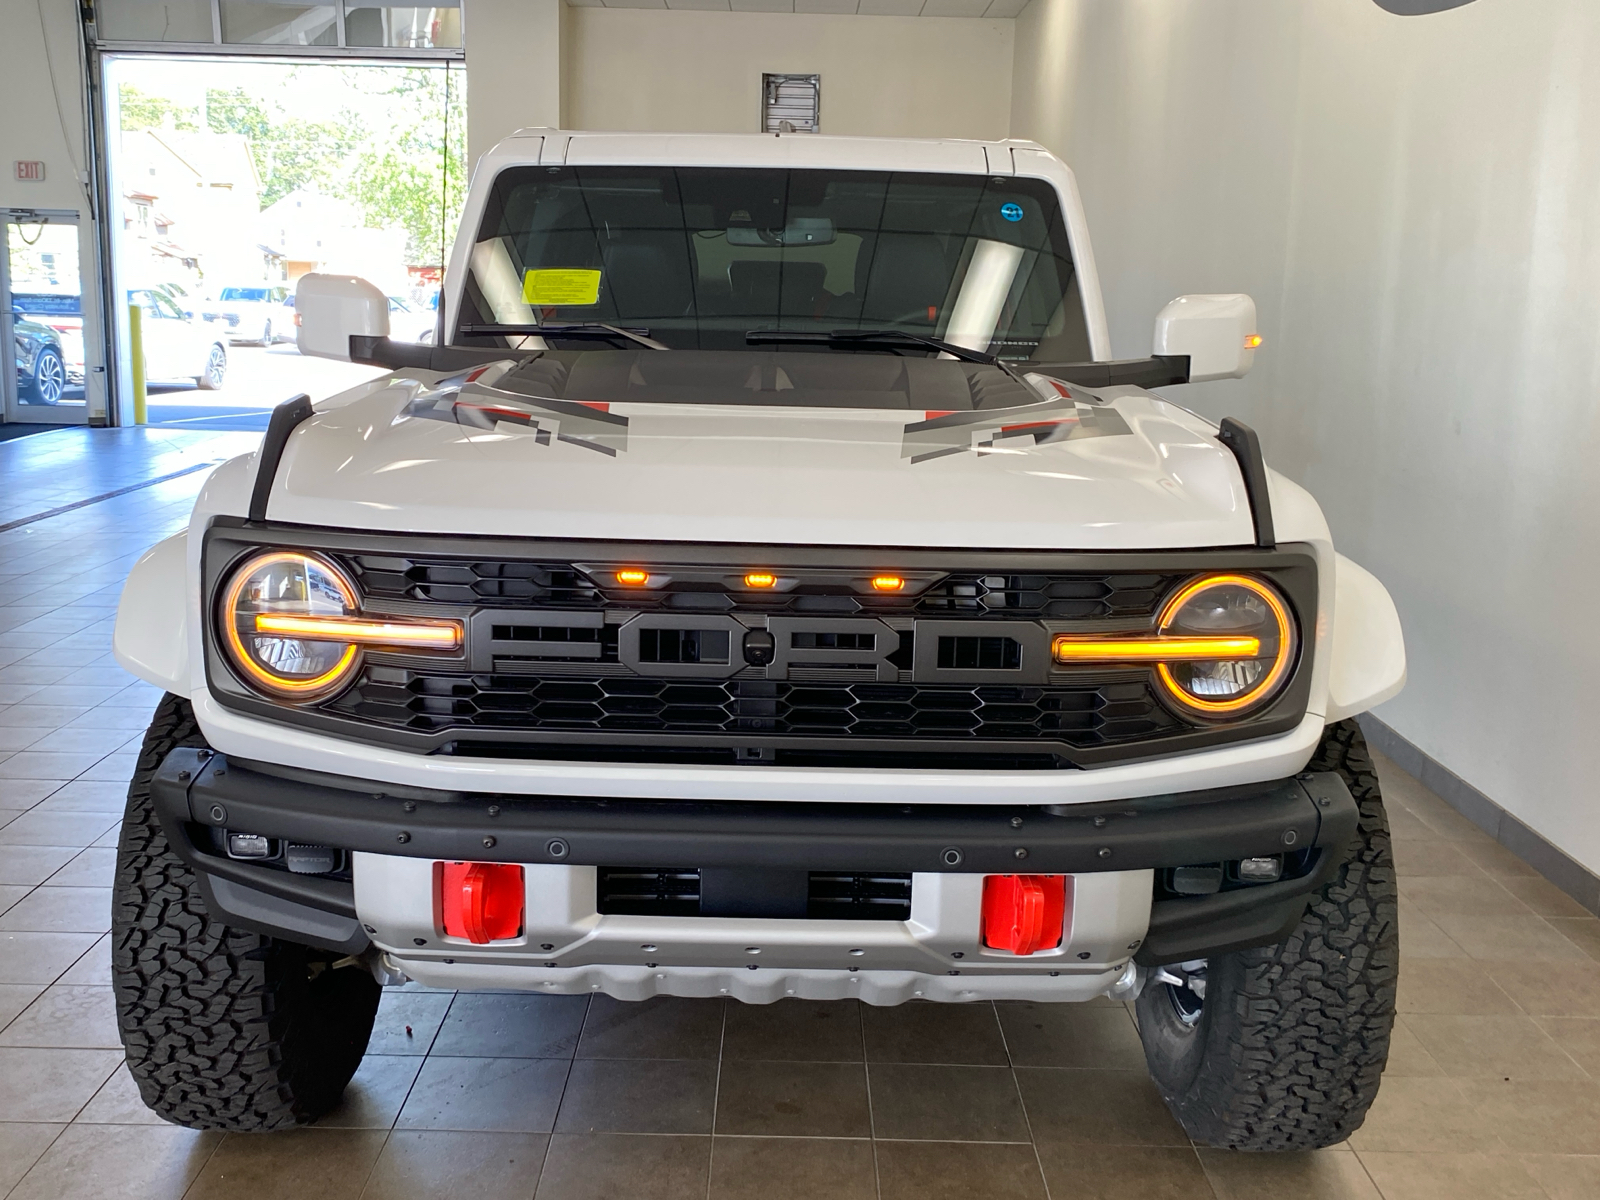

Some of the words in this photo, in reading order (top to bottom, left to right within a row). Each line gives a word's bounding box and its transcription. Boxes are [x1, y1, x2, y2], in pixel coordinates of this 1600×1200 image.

[17, 161, 39, 179] EXIT
[468, 609, 1049, 685] FORD
[288, 855, 331, 863] RAPTOR
